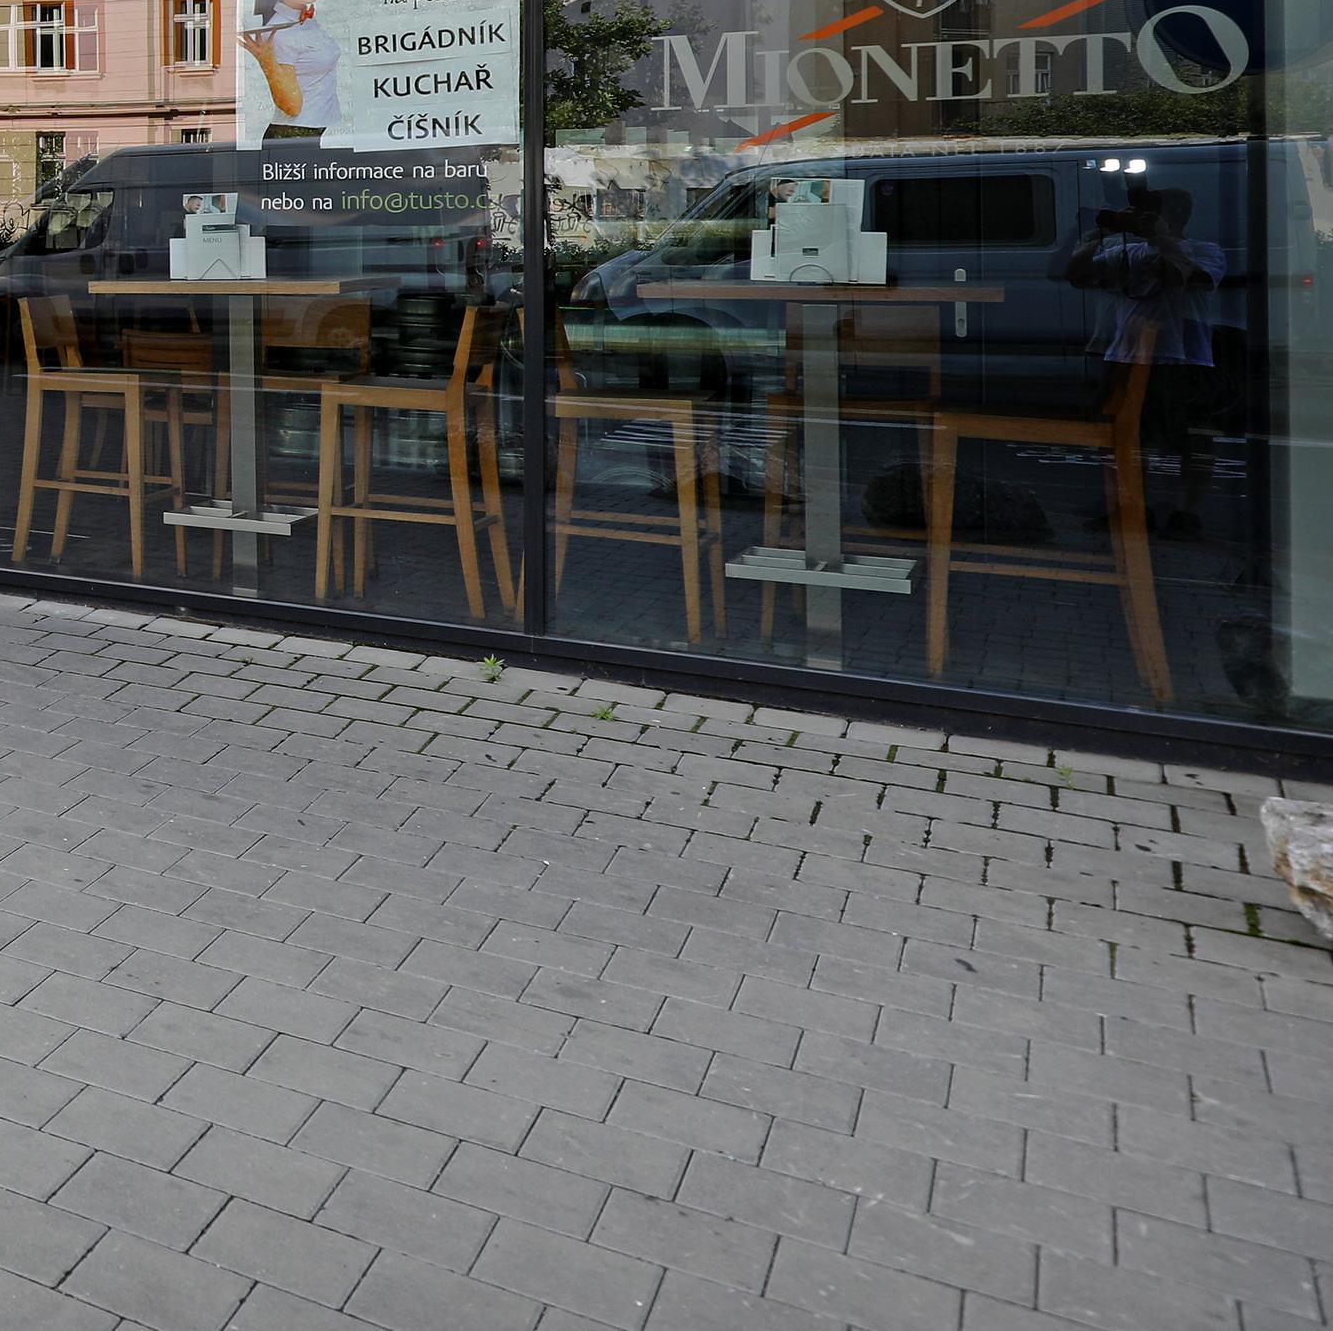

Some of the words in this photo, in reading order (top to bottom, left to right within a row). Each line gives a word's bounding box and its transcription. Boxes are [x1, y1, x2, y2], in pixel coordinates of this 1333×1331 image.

[357, 20, 507, 56] BRIGÁDNÍK
[373, 63, 495, 99] KUCHAŘ
[387, 110, 483, 141] ČÍŠNÍK
[262, 162, 308, 182] Bližší
[313, 161, 404, 180] informace
[412, 164, 435, 179] na
[444, 159, 488, 179] baru
[260, 191, 305, 211] nebo
[312, 196, 333, 210] na
[341, 189, 502, 213] info@tusto.cz
